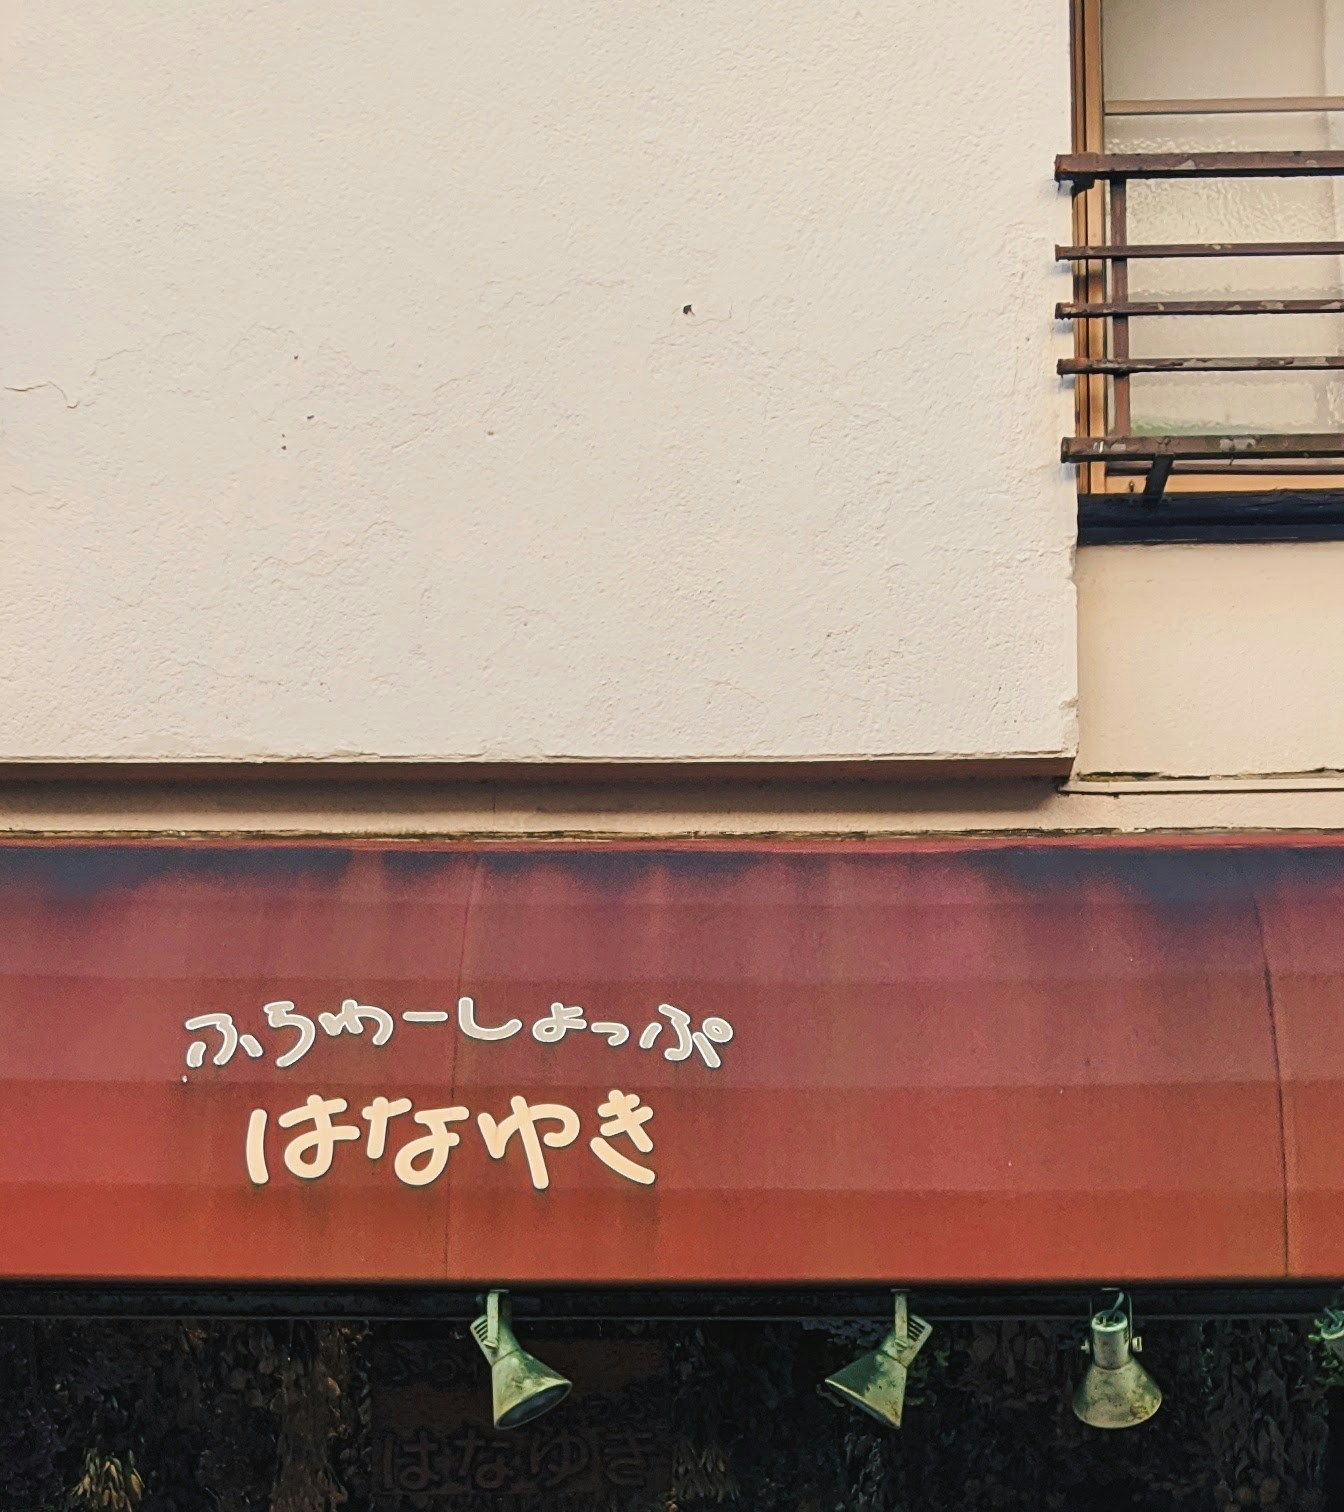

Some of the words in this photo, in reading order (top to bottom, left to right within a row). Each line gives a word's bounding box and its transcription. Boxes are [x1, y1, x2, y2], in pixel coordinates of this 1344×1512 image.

[185, 996, 733, 1068] ふらわーしょっぷ
[246, 1089, 656, 1190] はなゆき
[380, 1428, 654, 1491] はなゆき
